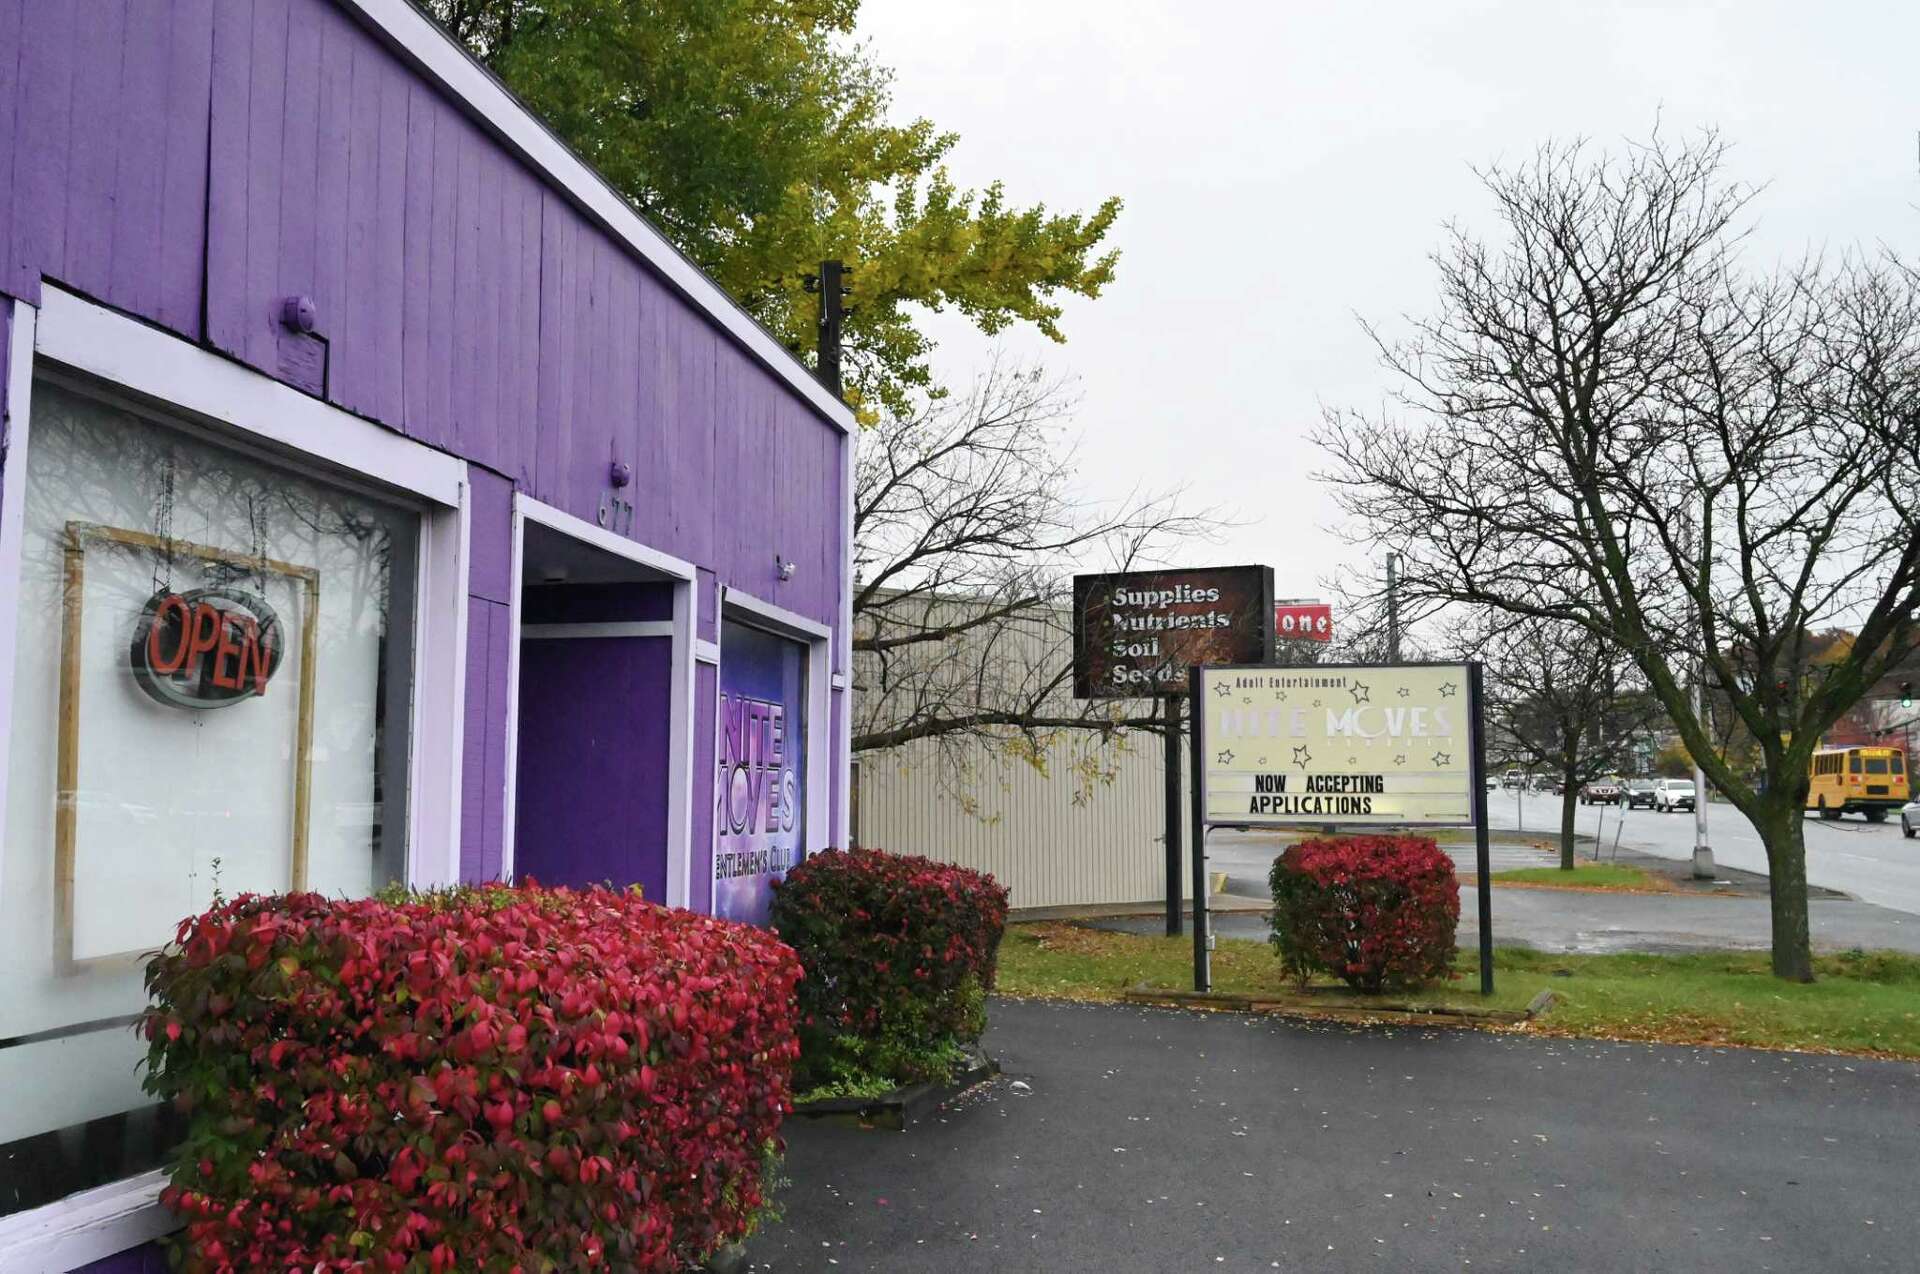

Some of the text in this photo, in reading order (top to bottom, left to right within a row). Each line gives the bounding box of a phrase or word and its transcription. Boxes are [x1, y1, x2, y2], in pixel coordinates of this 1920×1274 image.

[1112, 584, 1220, 609] Supplies
[1112, 611, 1231, 632] Nutrients
[1275, 613, 1328, 633] one
[150, 594, 275, 697] OPEN
[1112, 637, 1161, 658] Soil
[1112, 664, 1187, 684] Seeds
[1235, 675, 1348, 689] Adult Entertainment
[718, 693, 784, 768] NITE
[1219, 706, 1454, 738] NITE MOVES
[1255, 774, 1385, 794] NOW ACCEPTING
[1249, 795, 1373, 815] APPLICATIONS
